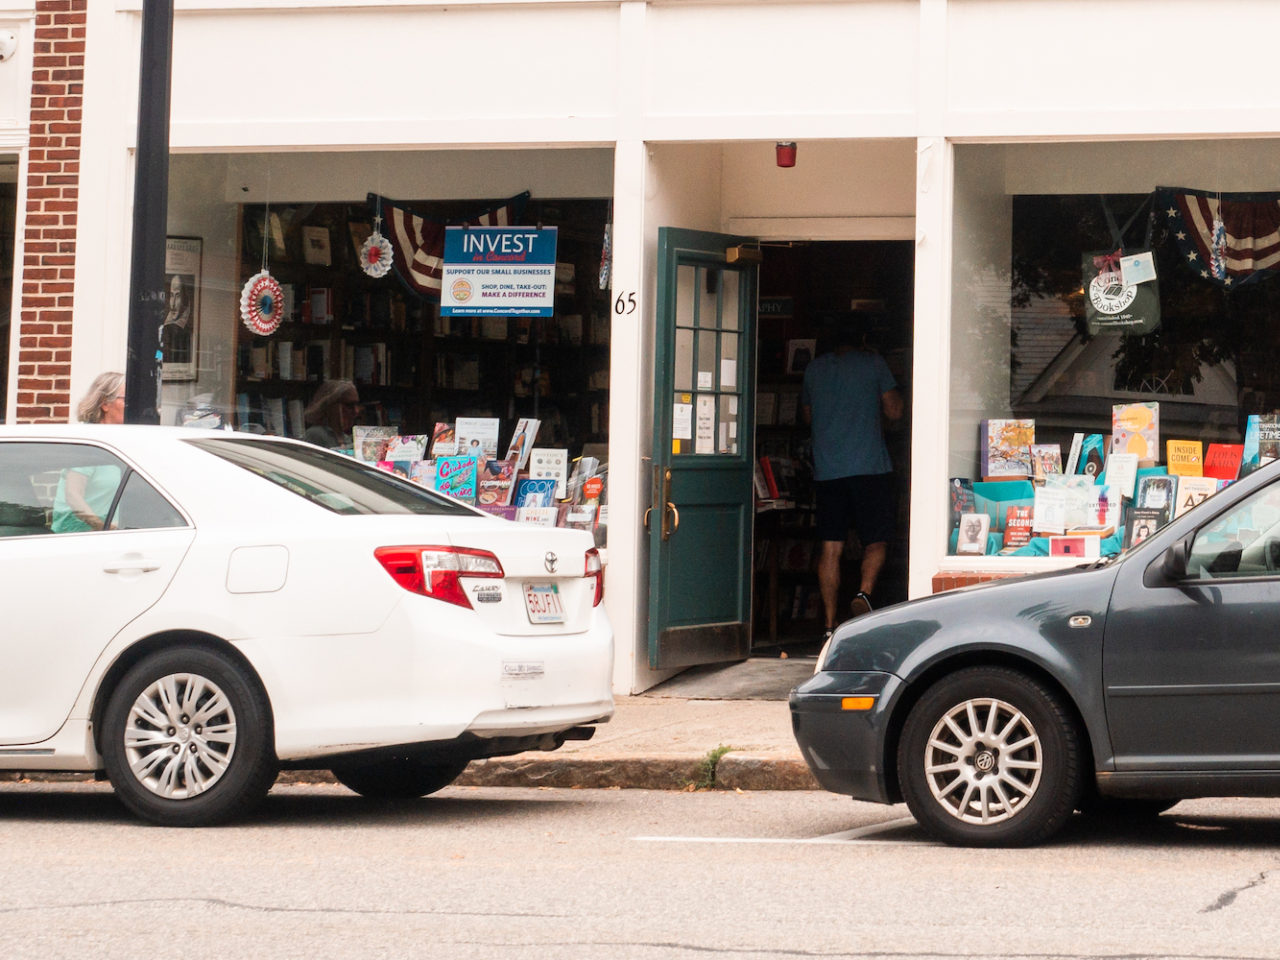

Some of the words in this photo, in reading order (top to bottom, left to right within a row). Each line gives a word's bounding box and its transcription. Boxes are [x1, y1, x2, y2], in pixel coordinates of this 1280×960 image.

[463, 234, 538, 253] INVEST
[486, 251, 526, 262] Concord
[615, 290, 636, 315] 65
[1092, 290, 1134, 312] Bookshop
[1174, 446, 1197, 454] INSIDE
[520, 481, 554, 497] COOK
[1008, 519, 1033, 527] SECOND
